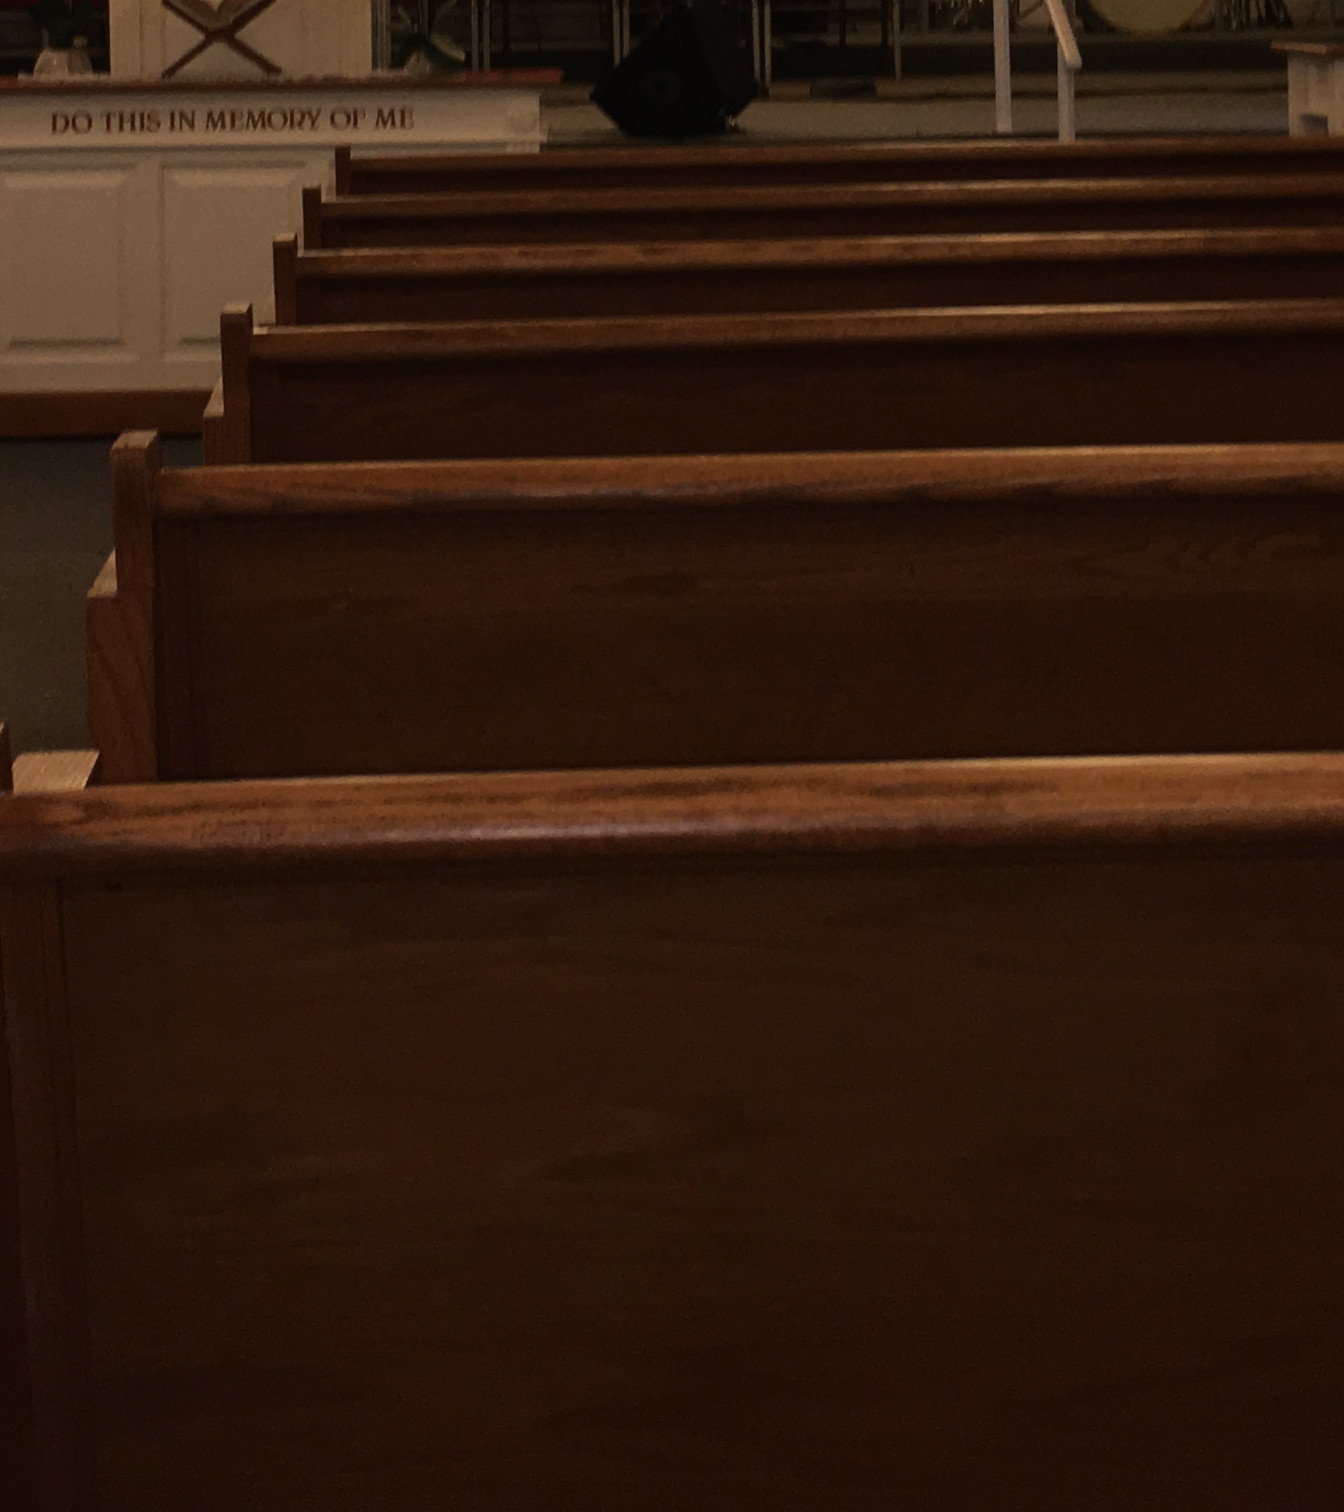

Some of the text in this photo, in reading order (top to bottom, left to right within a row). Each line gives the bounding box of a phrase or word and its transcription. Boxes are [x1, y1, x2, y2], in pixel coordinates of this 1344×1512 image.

[50, 104, 415, 135] DO THIS IN MEMORY OF ME
